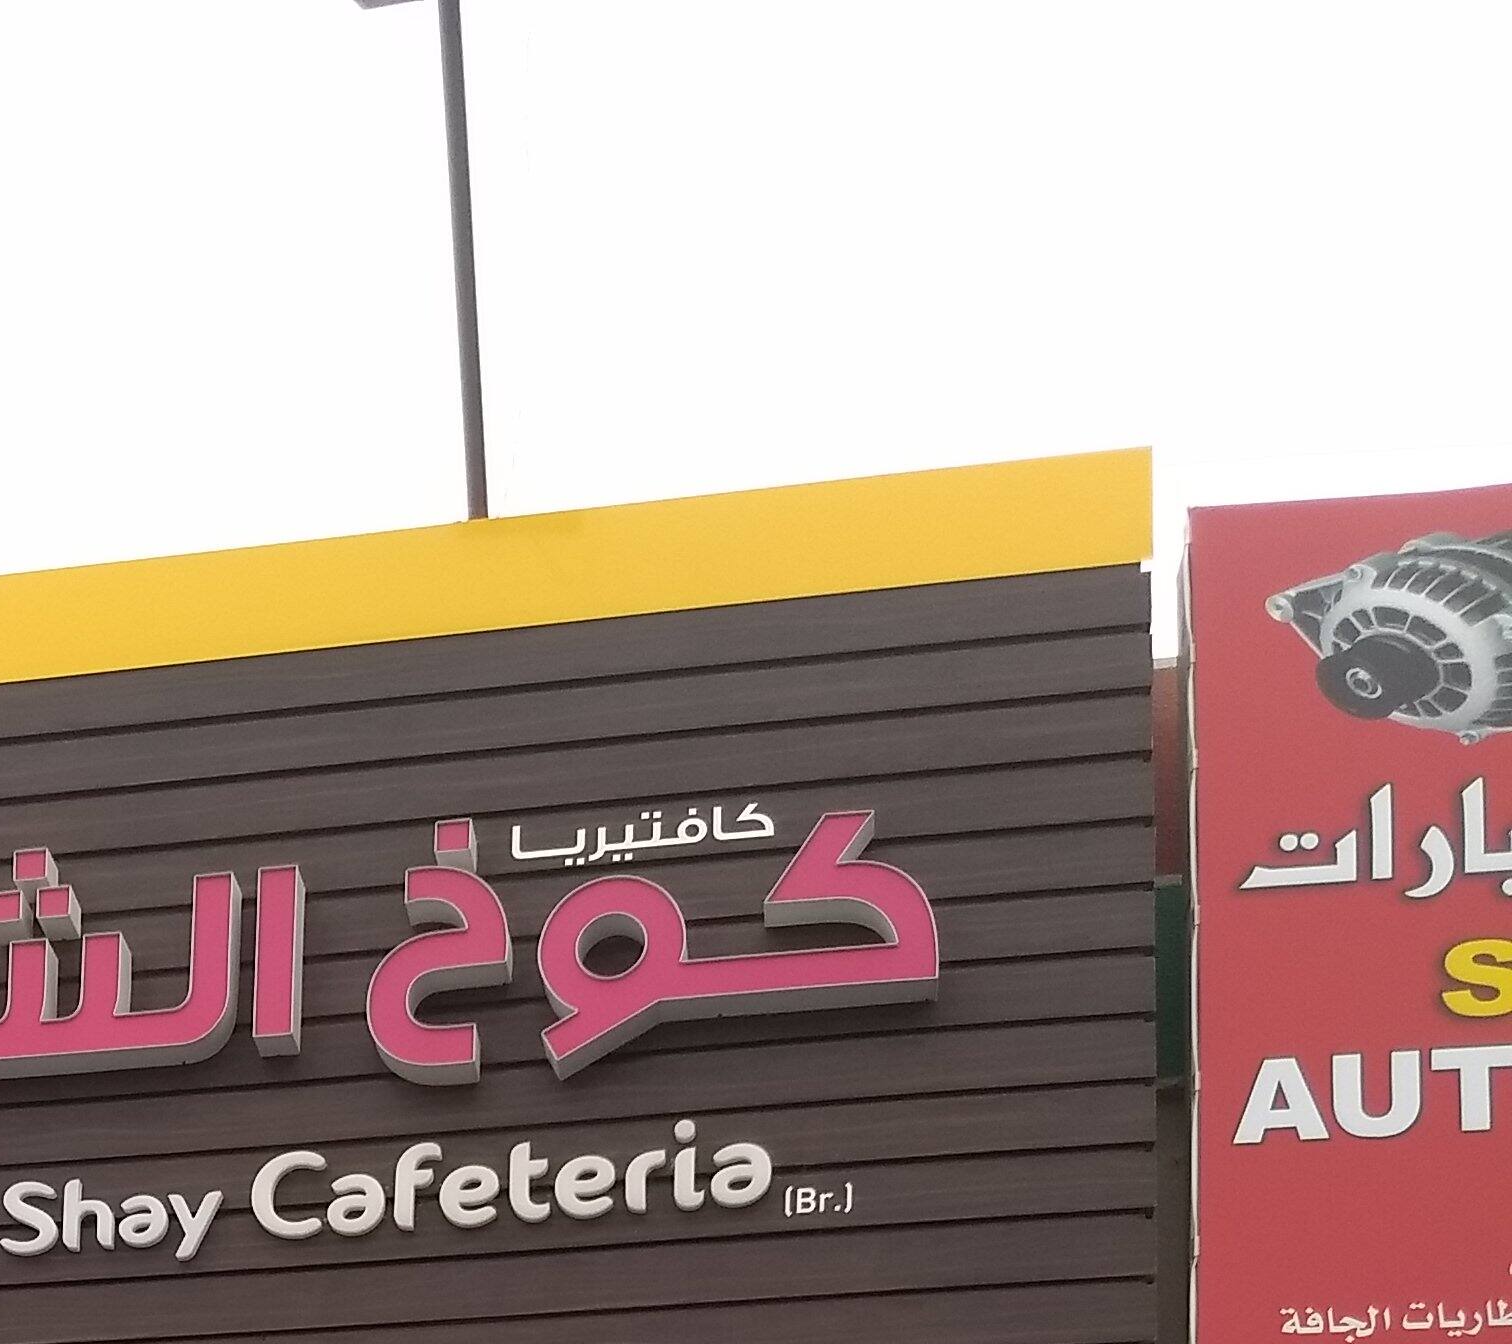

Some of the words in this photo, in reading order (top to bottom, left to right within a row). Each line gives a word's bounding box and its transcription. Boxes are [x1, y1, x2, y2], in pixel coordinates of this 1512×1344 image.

[511, 803, 776, 866] كافتيريا
[367, 809, 939, 1086] كوخ
[1233, 1044, 1512, 1145] AUT
[0, 1179, 224, 1262] Shay
[250, 1119, 774, 1240] Cafeteria
[784, 1183, 854, 1218] (Br.)
[1280, 1304, 1392, 1343] الجافة
